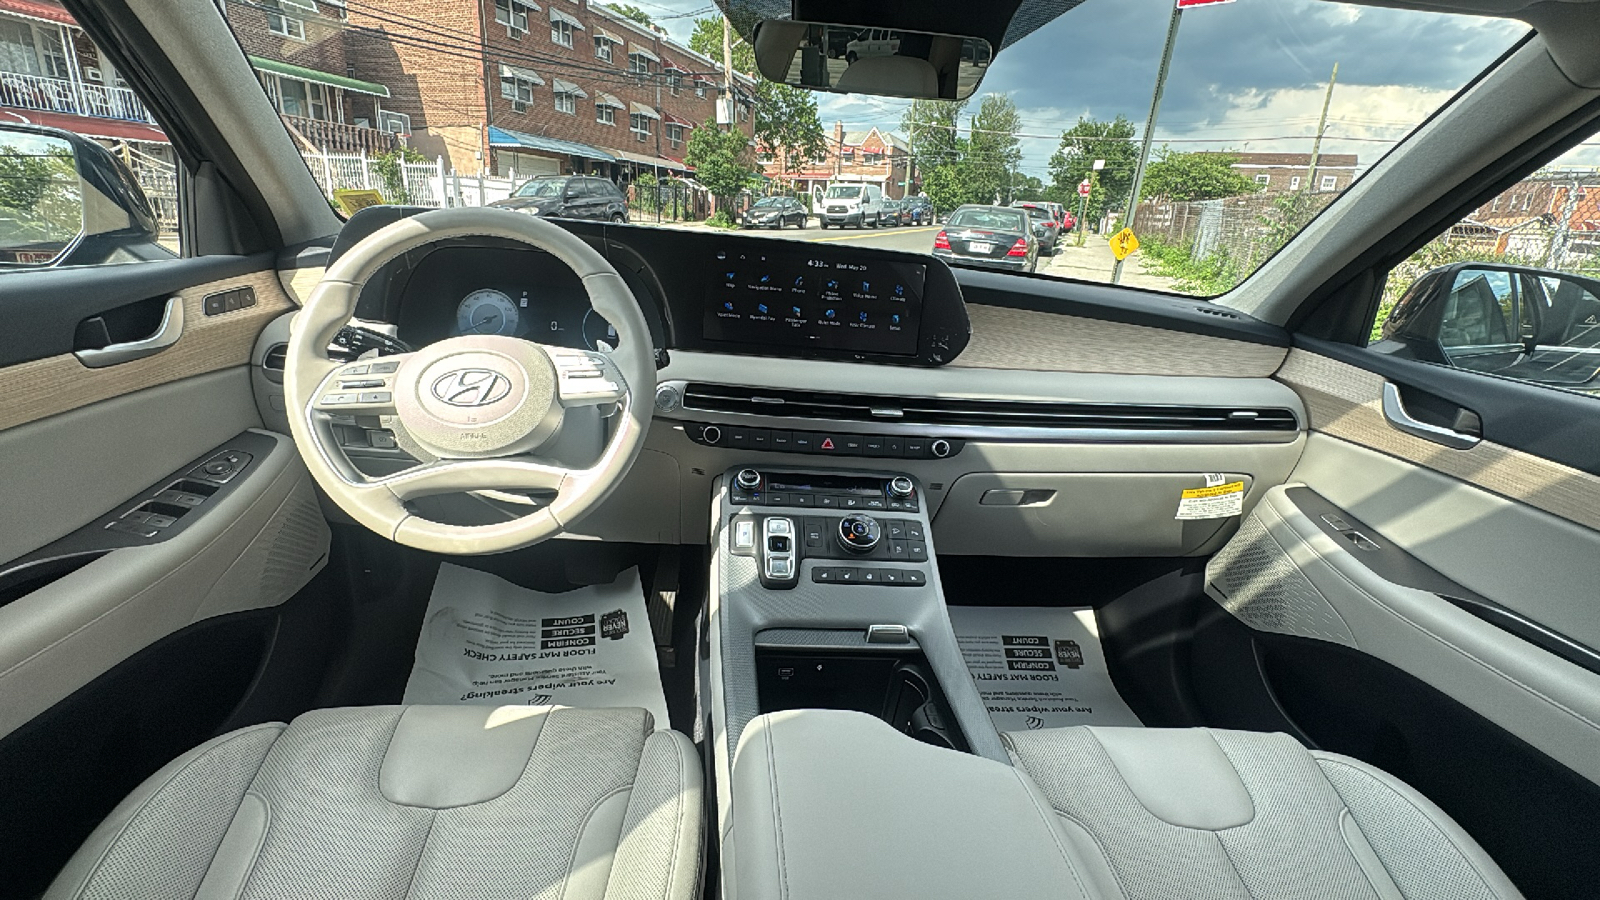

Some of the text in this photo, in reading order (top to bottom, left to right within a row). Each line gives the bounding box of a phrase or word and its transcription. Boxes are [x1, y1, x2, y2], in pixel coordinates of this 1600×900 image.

[553, 618, 584, 626] COUNT
[603, 620, 626, 631] NEVER
[552, 628, 585, 636] SECURE
[547, 638, 589, 647] CONFIRM
[463, 647, 596, 661] FLOOR MAT SAFETY CHECK
[1013, 649, 1043, 657] SECURE
[1013, 661, 1049, 669] CONFIRM
[460, 678, 615, 701] Are your wipers streaking?
